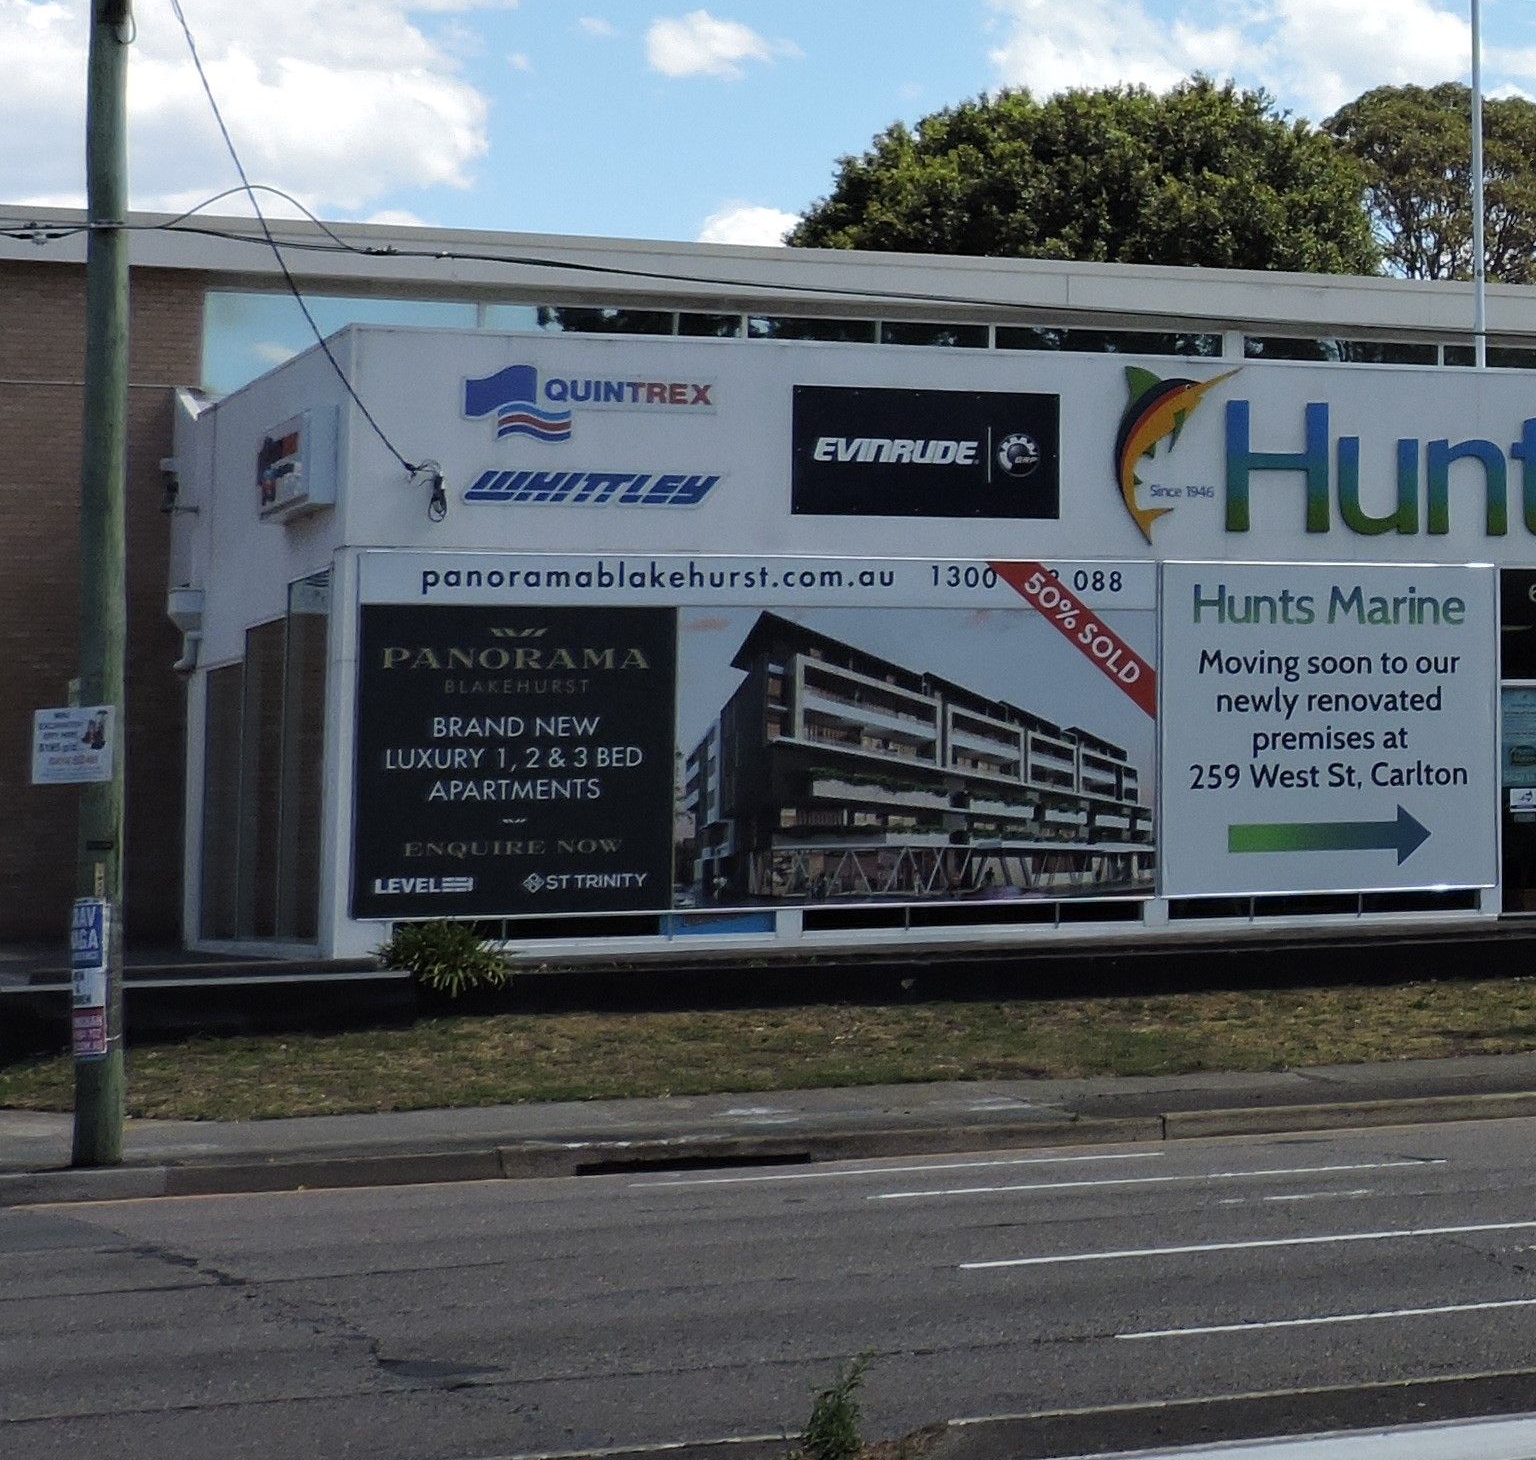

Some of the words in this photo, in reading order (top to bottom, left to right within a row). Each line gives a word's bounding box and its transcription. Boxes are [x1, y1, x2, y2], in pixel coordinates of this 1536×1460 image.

[545, 378, 711, 406] QUINTREX
[814, 437, 979, 464] EVINRUDE
[465, 469, 721, 505] WHITTLEY
[1150, 484, 1182, 497] Since
[1186, 485, 1215, 498] 1946
[421, 561, 895, 594] panoramablakehurst.com.au
[932, 565, 998, 589] 1300
[1073, 569, 1123, 593] 088
[1192, 584, 1315, 625] Hunts
[1327, 585, 1466, 625] Marine
[1024, 572, 1080, 629] 50%
[1078, 623, 1141, 684] SOLD
[381, 646, 650, 670] PANORAMA
[1198, 649, 1300, 682] Moving
[1307, 656, 1372, 675] soon
[1380, 653, 1408, 675] to
[1415, 656, 1460, 674] our
[443, 678, 591, 695] BLAKEHURST
[1217, 686, 1299, 720] newly
[1307, 686, 1442, 712] renovated
[433, 716, 524, 738] BRAND
[535, 716, 601, 737] NEW
[1252, 725, 1375, 758] premises
[1382, 728, 1408, 749] at
[386, 748, 485, 770] LUXURY
[526, 748, 540, 768] 2
[548, 748, 565, 768] &
[573, 747, 587, 768] 3
[597, 746, 643, 768] BED
[1190, 764, 1240, 790] 259
[1250, 763, 1320, 788] West
[1328, 763, 1362, 790] St,
[1371, 760, 1468, 787] Carlton
[428, 778, 601, 802] APARTMENTS
[404, 839, 546, 860] ENQUIRE
[557, 838, 623, 854] NOW
[546, 874, 570, 890] ST
[574, 872, 648, 889] TRINITY
